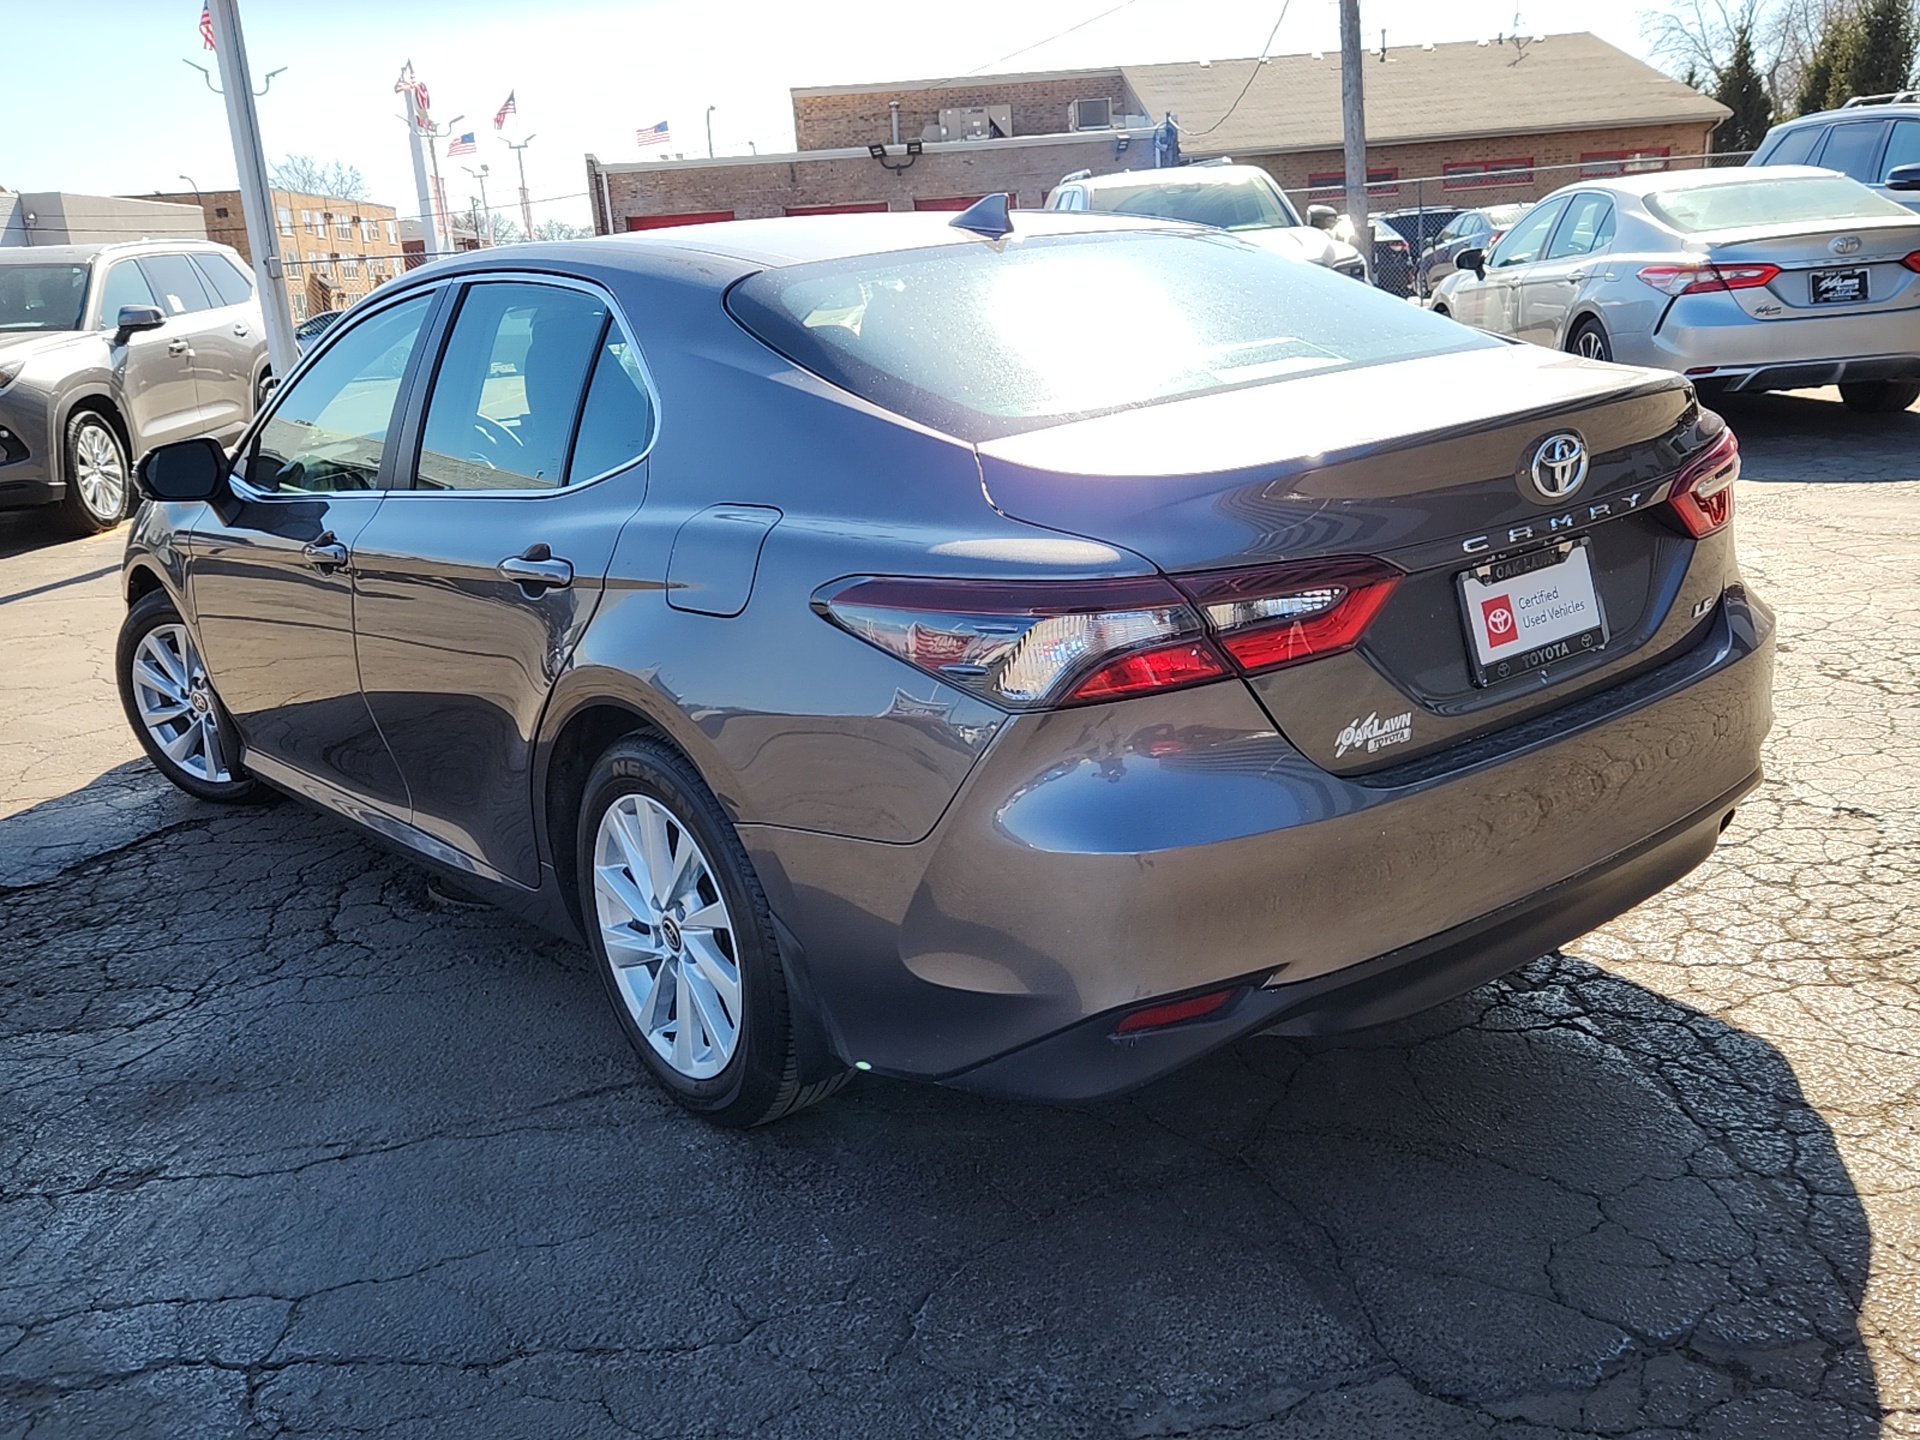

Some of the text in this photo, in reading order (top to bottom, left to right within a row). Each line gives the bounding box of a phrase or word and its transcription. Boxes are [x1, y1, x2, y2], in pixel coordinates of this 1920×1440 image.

[1462, 492, 1642, 553] CAMRY
[1495, 561, 1522, 580] OAK
[1518, 585, 1560, 611] Certified
[1692, 597, 1714, 619] LE
[1522, 600, 1585, 629] Used Vehicles
[1522, 642, 1570, 668] TOYOTA
[1373, 731, 1406, 748] TOYOTA
[611, 760, 696, 822] NEXEN
